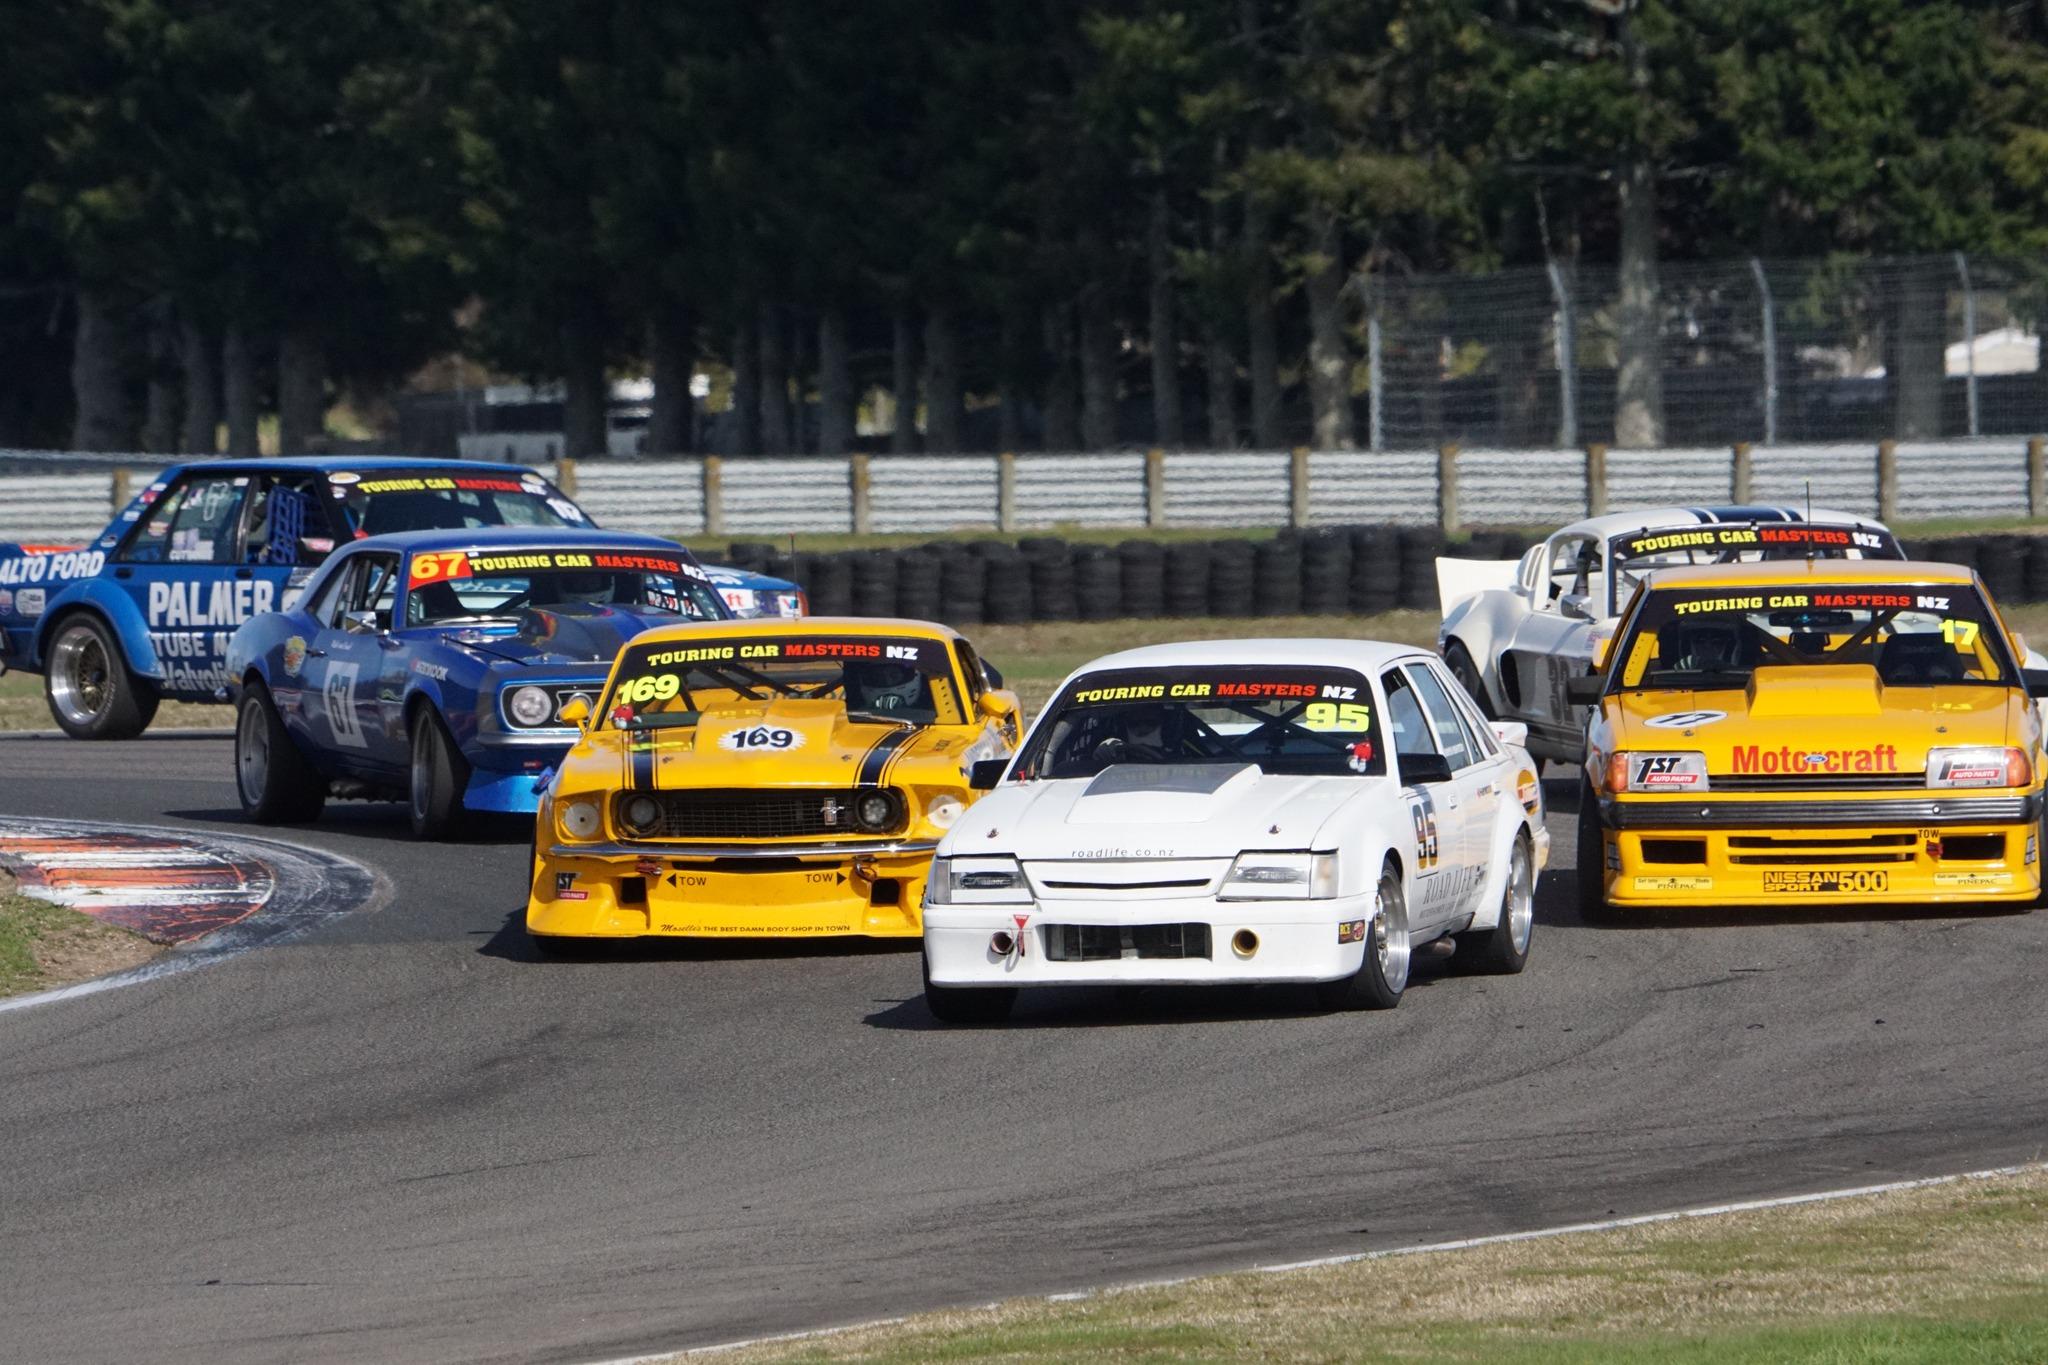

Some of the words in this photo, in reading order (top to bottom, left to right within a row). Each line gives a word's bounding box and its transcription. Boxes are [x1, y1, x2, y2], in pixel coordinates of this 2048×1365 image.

[357, 479, 426, 493] TOURING
[425, 478, 456, 489] CAR
[1631, 532, 1715, 553] TOURING
[1719, 531, 1758, 544] CAR
[1760, 529, 1849, 544] MASTERS
[1852, 532, 1882, 548] NZ
[48, 550, 105, 580] FORD
[411, 553, 465, 579] 67
[469, 555, 552, 571] TOURING
[554, 554, 592, 567] CAR
[595, 555, 680, 572] MASTERS
[681, 563, 708, 581] NZ
[149, 580, 274, 626] PALMER
[1674, 596, 1763, 615] TOURING
[1769, 595, 1809, 608] CAR
[1814, 594, 1911, 607] MASTERS
[1917, 596, 1950, 610] NZ
[147, 631, 206, 657] TUBE
[1938, 619, 1979, 646] 17
[647, 647, 734, 667] TOURING
[740, 645, 780, 658] CAR
[785, 644, 880, 657] MASTERS
[886, 645, 919, 660] NZ
[618, 674, 680, 705] 169
[1076, 685, 1165, 703] TOURING
[1170, 684, 1211, 697] CAR
[1217, 684, 1318, 697] MASTERS
[1322, 685, 1357, 700] NZ
[1306, 702, 1370, 733] 95
[732, 729, 793, 748] 169
[1636, 757, 1682, 783] 1ST
[1651, 775, 1671, 783] AUTO
[1671, 775, 1693, 783] PARTS
[1412, 800, 1438, 869] 95
[1918, 830, 1939, 838] TOW
[1071, 848, 1175, 858] roadlife.co.nz
[680, 877, 707, 886] TOW
[805, 874, 834, 883] TOW
[1423, 872, 1452, 904] ROAD
[1451, 865, 1474, 897] LIFE
[1765, 872, 1838, 883] NISSAN
[1765, 883, 1822, 892] SPORT
[1838, 871, 1887, 892] 500
